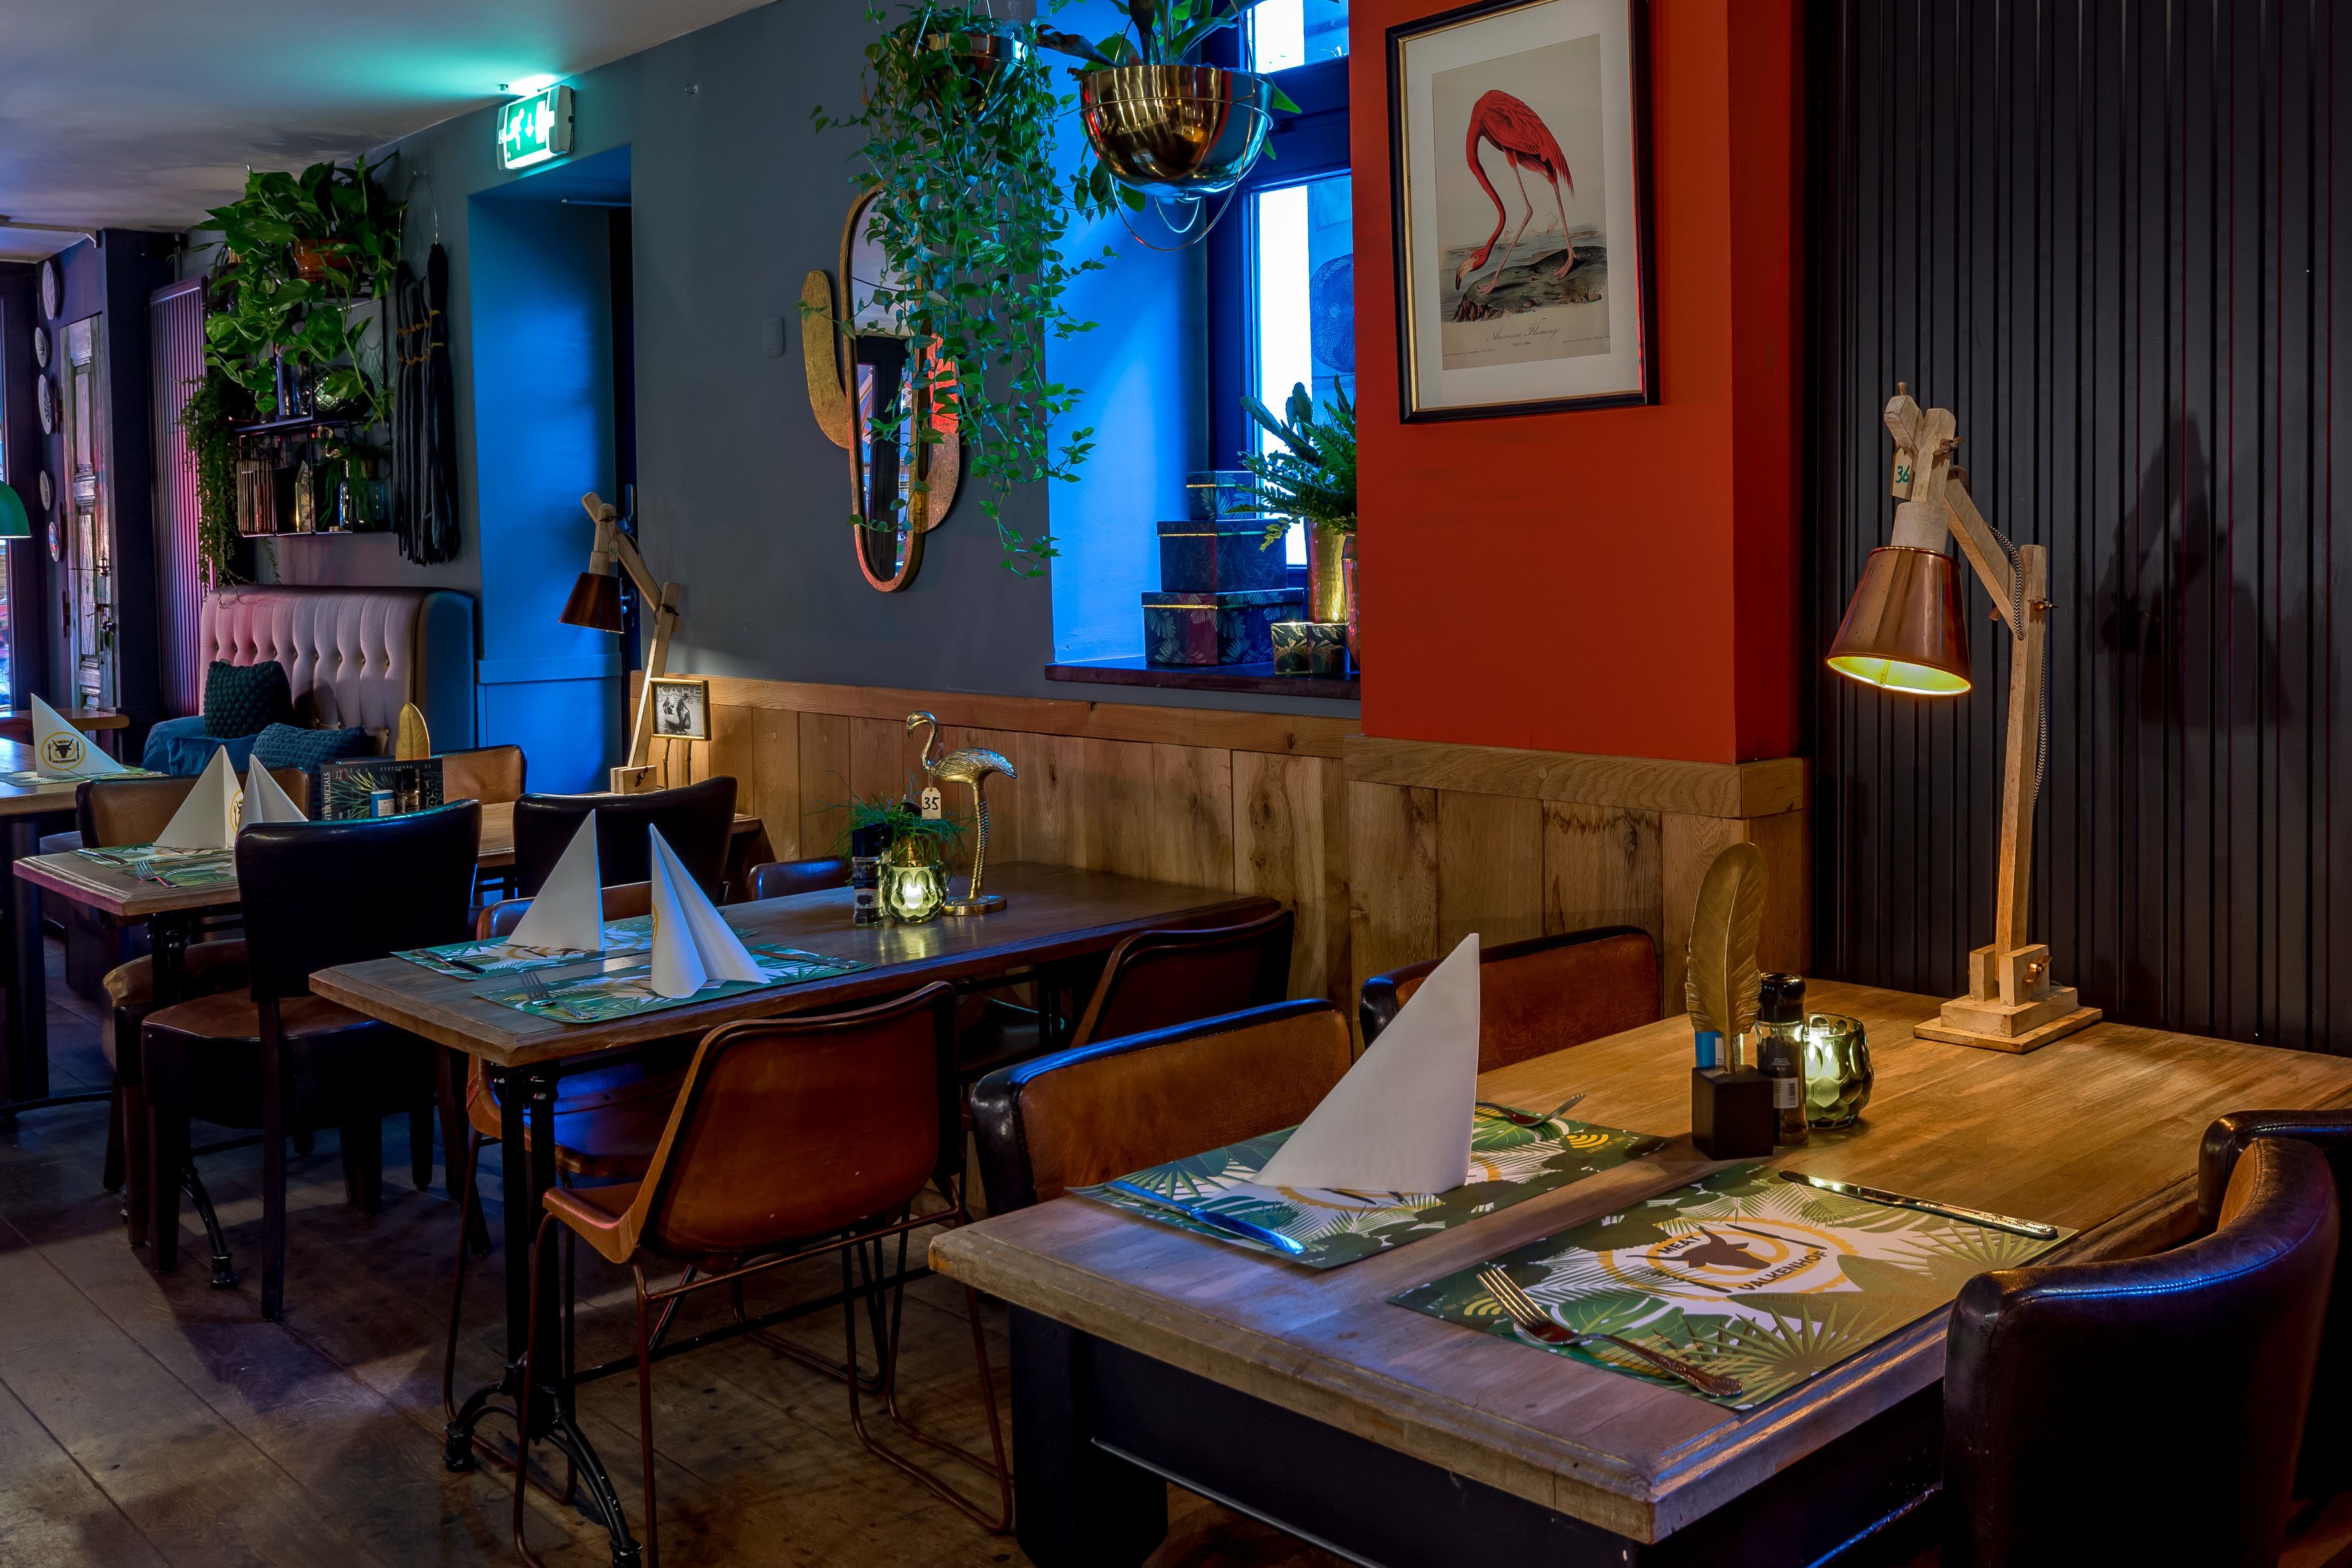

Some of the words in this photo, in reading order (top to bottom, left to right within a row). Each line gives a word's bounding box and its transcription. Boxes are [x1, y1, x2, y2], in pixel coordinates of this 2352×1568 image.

[1523, 318, 1561, 340] Flamingo
[1895, 464, 1910, 483] 36
[656, 685, 702, 697] KARE
[922, 797, 940, 811] 35
[1656, 1235, 1701, 1254] MEAT
[1737, 1250, 1827, 1290] VALKENHOF
